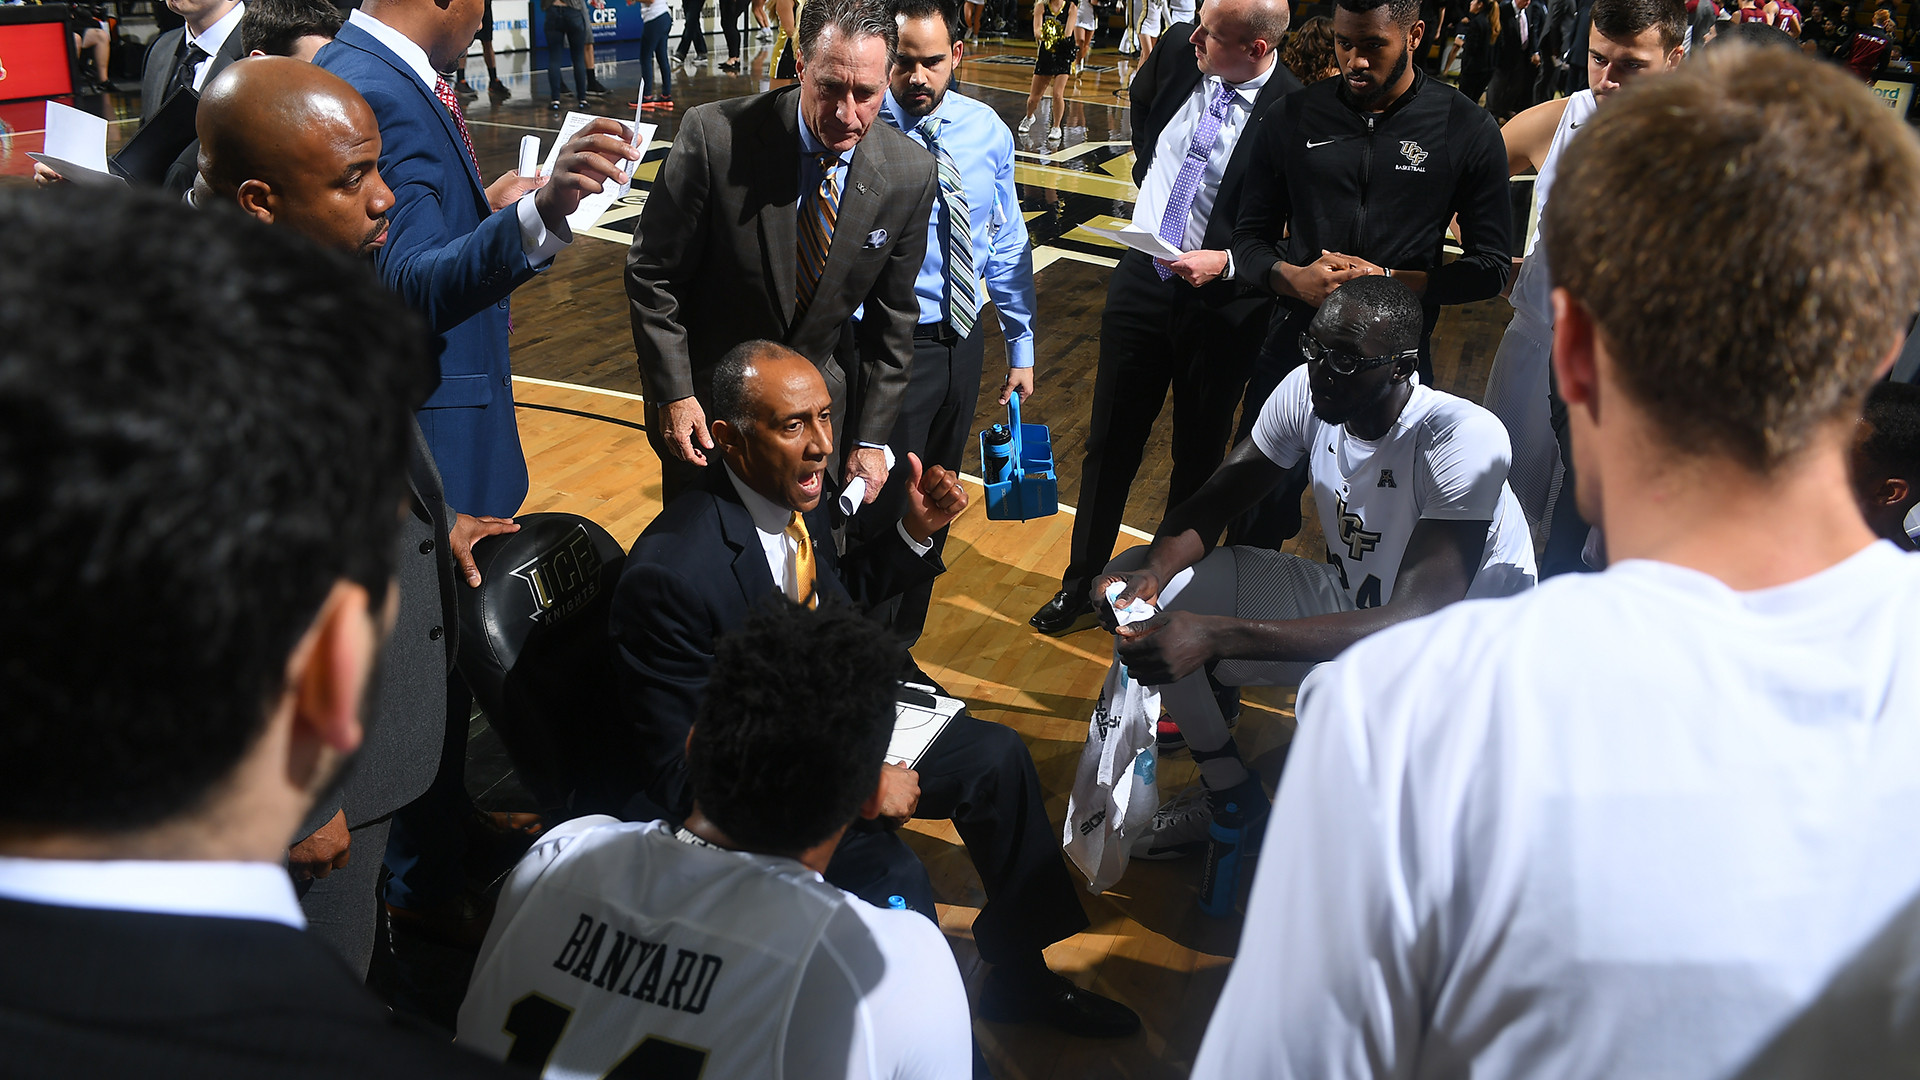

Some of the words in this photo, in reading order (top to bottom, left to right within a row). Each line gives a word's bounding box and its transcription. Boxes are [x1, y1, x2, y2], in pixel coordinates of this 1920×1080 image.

[592, 7, 617, 23] CFE
[1399, 140, 1429, 166] UCF
[543, 580, 596, 627] KNIGHTS
[552, 912, 723, 1015] BANYARD
